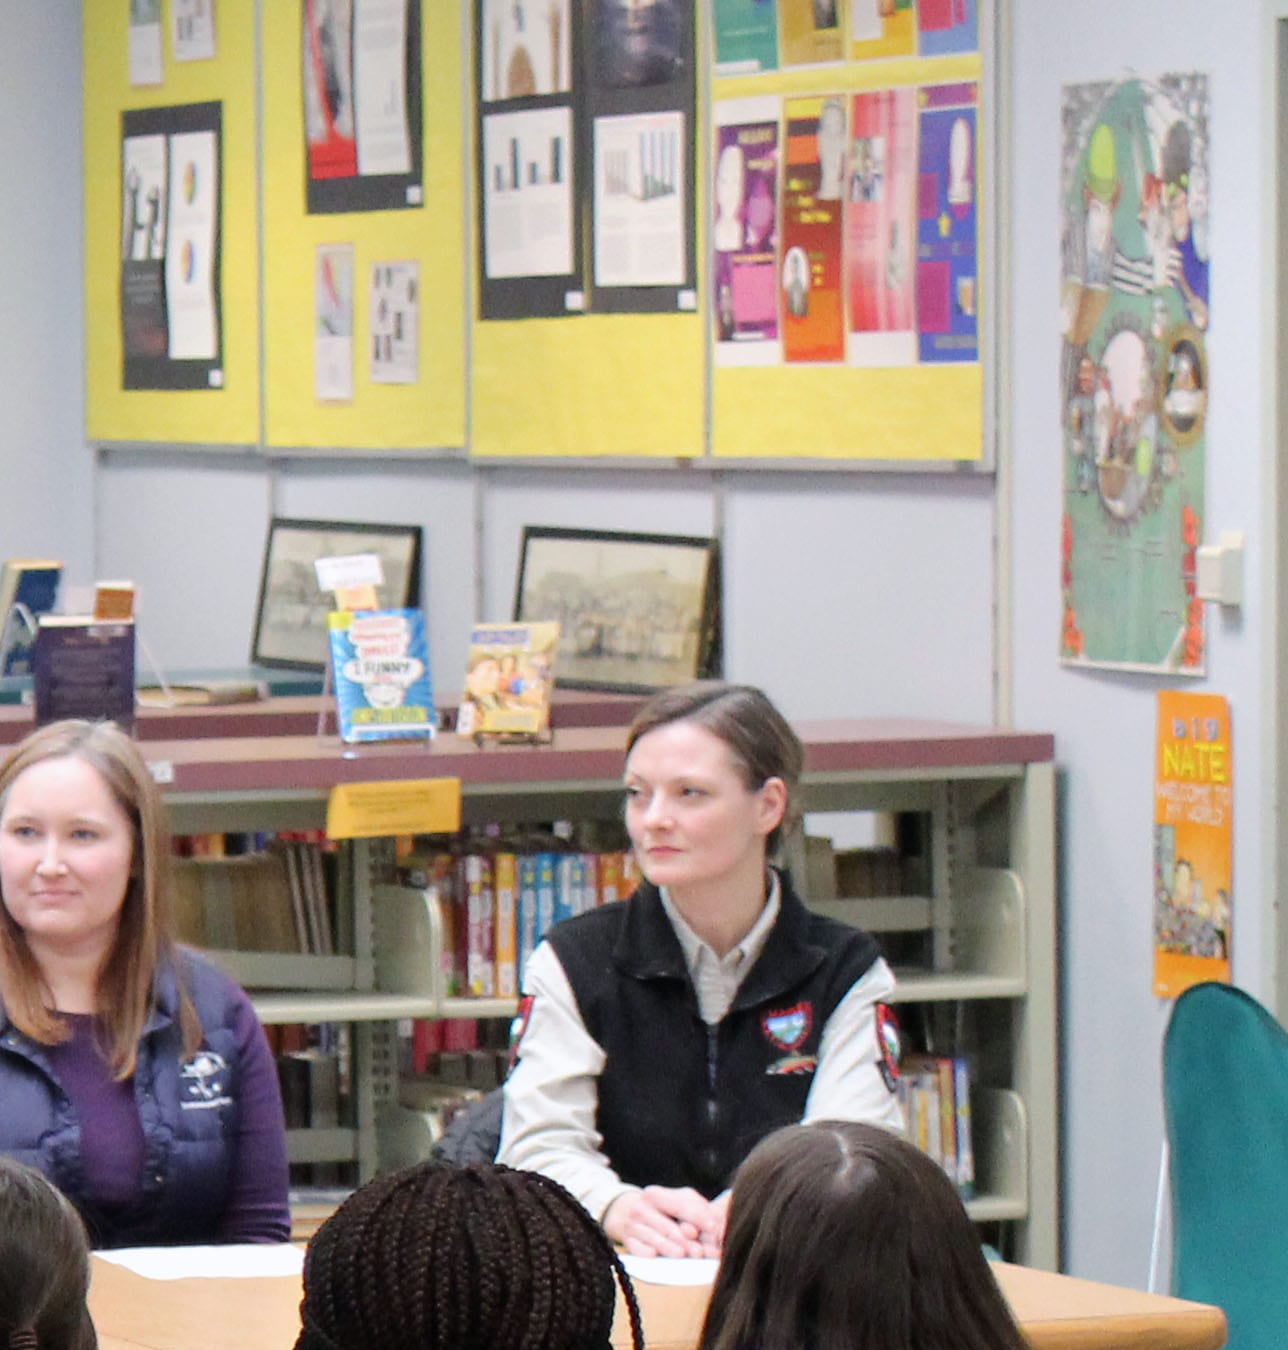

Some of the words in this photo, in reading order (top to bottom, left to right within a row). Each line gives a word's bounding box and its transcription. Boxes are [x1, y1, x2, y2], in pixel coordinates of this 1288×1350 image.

[365, 661, 411, 677] FUNNY
[1172, 717, 1219, 742] big
[1162, 743, 1228, 783] NATE
